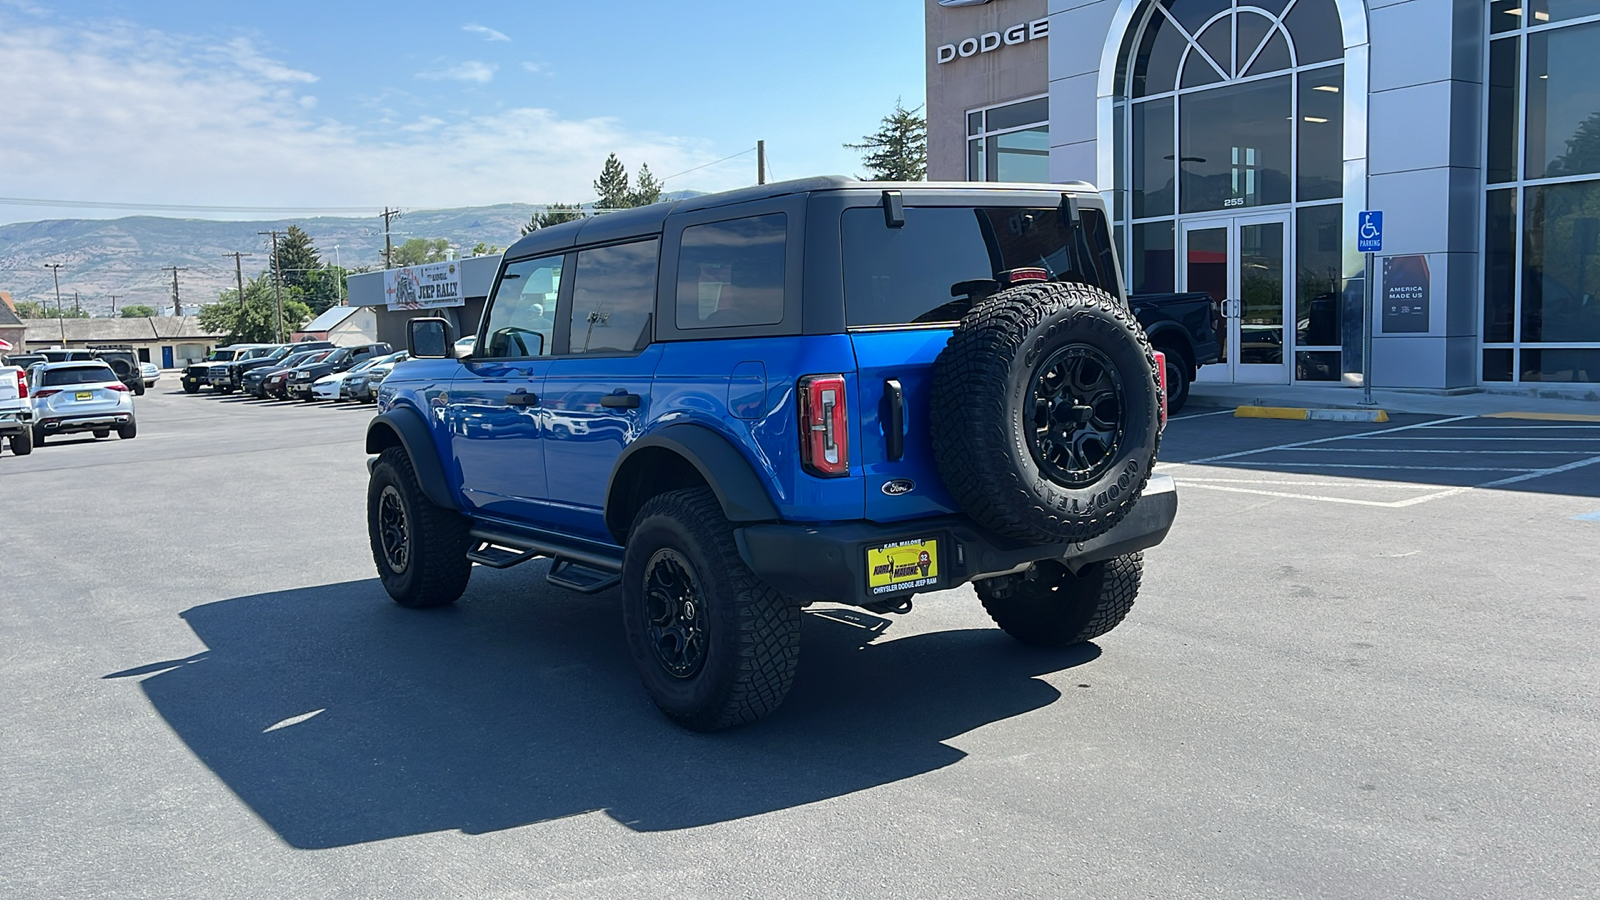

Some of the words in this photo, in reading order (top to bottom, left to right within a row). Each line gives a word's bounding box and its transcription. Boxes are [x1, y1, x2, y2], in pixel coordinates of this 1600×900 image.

[937, 16, 1049, 64] DODGE
[1224, 197, 1244, 206] 255
[1360, 239, 1380, 247] PARKING
[418, 284, 435, 299] JEEP
[436, 282, 458, 298] RALLY
[883, 542, 899, 550] KARL
[899, 539, 922, 547] MALONE
[920, 553, 928, 561] 32
[873, 584, 898, 594] CHRYSLER
[898, 581, 915, 590] DODGE
[914, 579, 926, 587] JEEP
[926, 577, 937, 585] RAM
